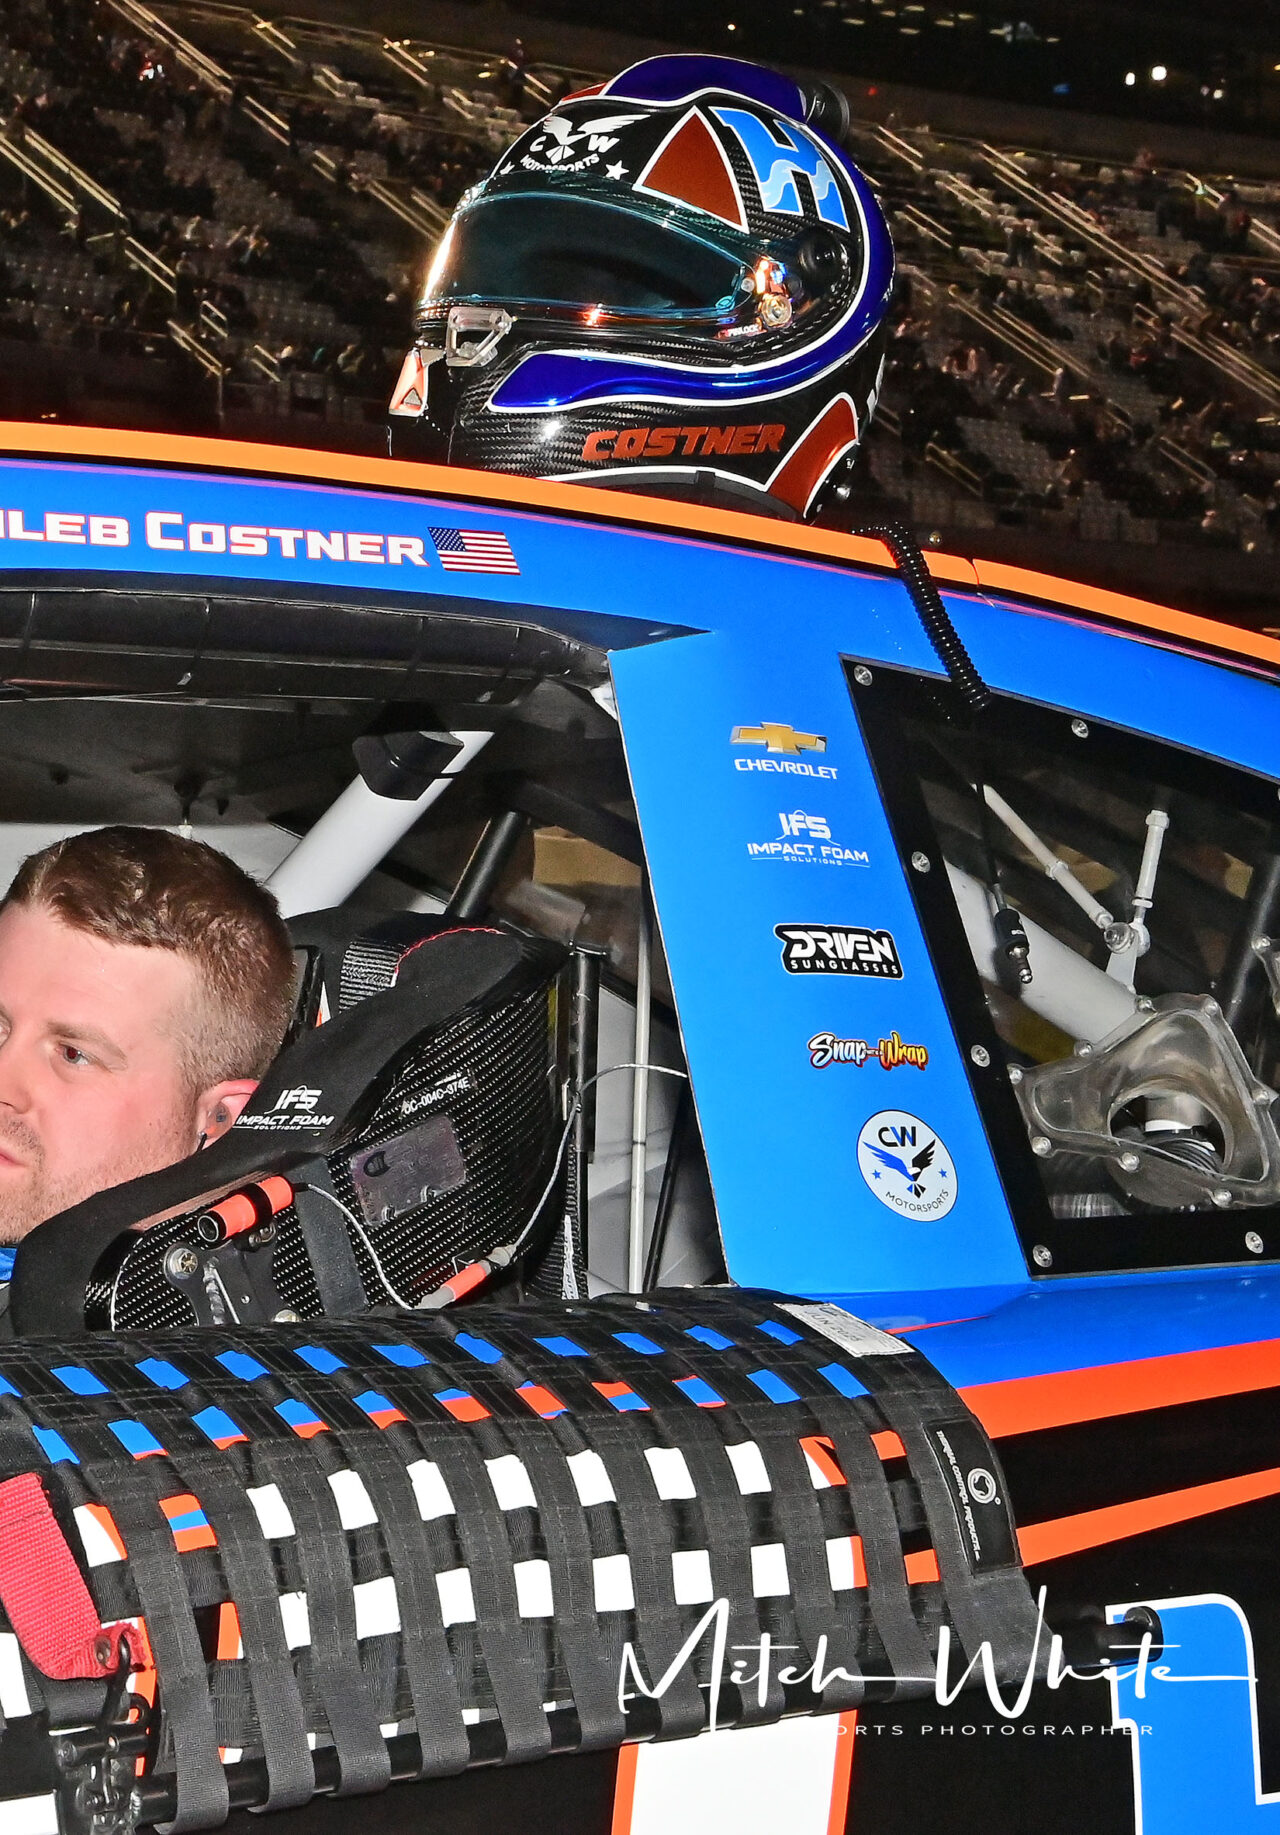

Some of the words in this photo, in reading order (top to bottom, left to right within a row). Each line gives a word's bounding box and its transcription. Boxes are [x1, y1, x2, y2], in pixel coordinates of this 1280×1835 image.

[582, 423, 787, 461] COSTNER
[144, 511, 430, 567] COSTNER
[734, 758, 838, 780] CHEVROLET
[778, 811, 832, 840] IFS
[747, 842, 815, 857] IMPACT
[821, 845, 869, 863] FOAM
[783, 856, 843, 866] SOLUTIONS
[782, 930, 895, 963] DRIVEN
[790, 958, 898, 975] SUNGLASSES
[878, 1030, 929, 1071] Wrap
[273, 1086, 322, 1110] IFS
[235, 1115, 290, 1126] IMPACT
[289, 1115, 335, 1126] FOAM
[877, 1125, 917, 1147] CW
[885, 1188, 950, 1213] MOTORSPORTS
